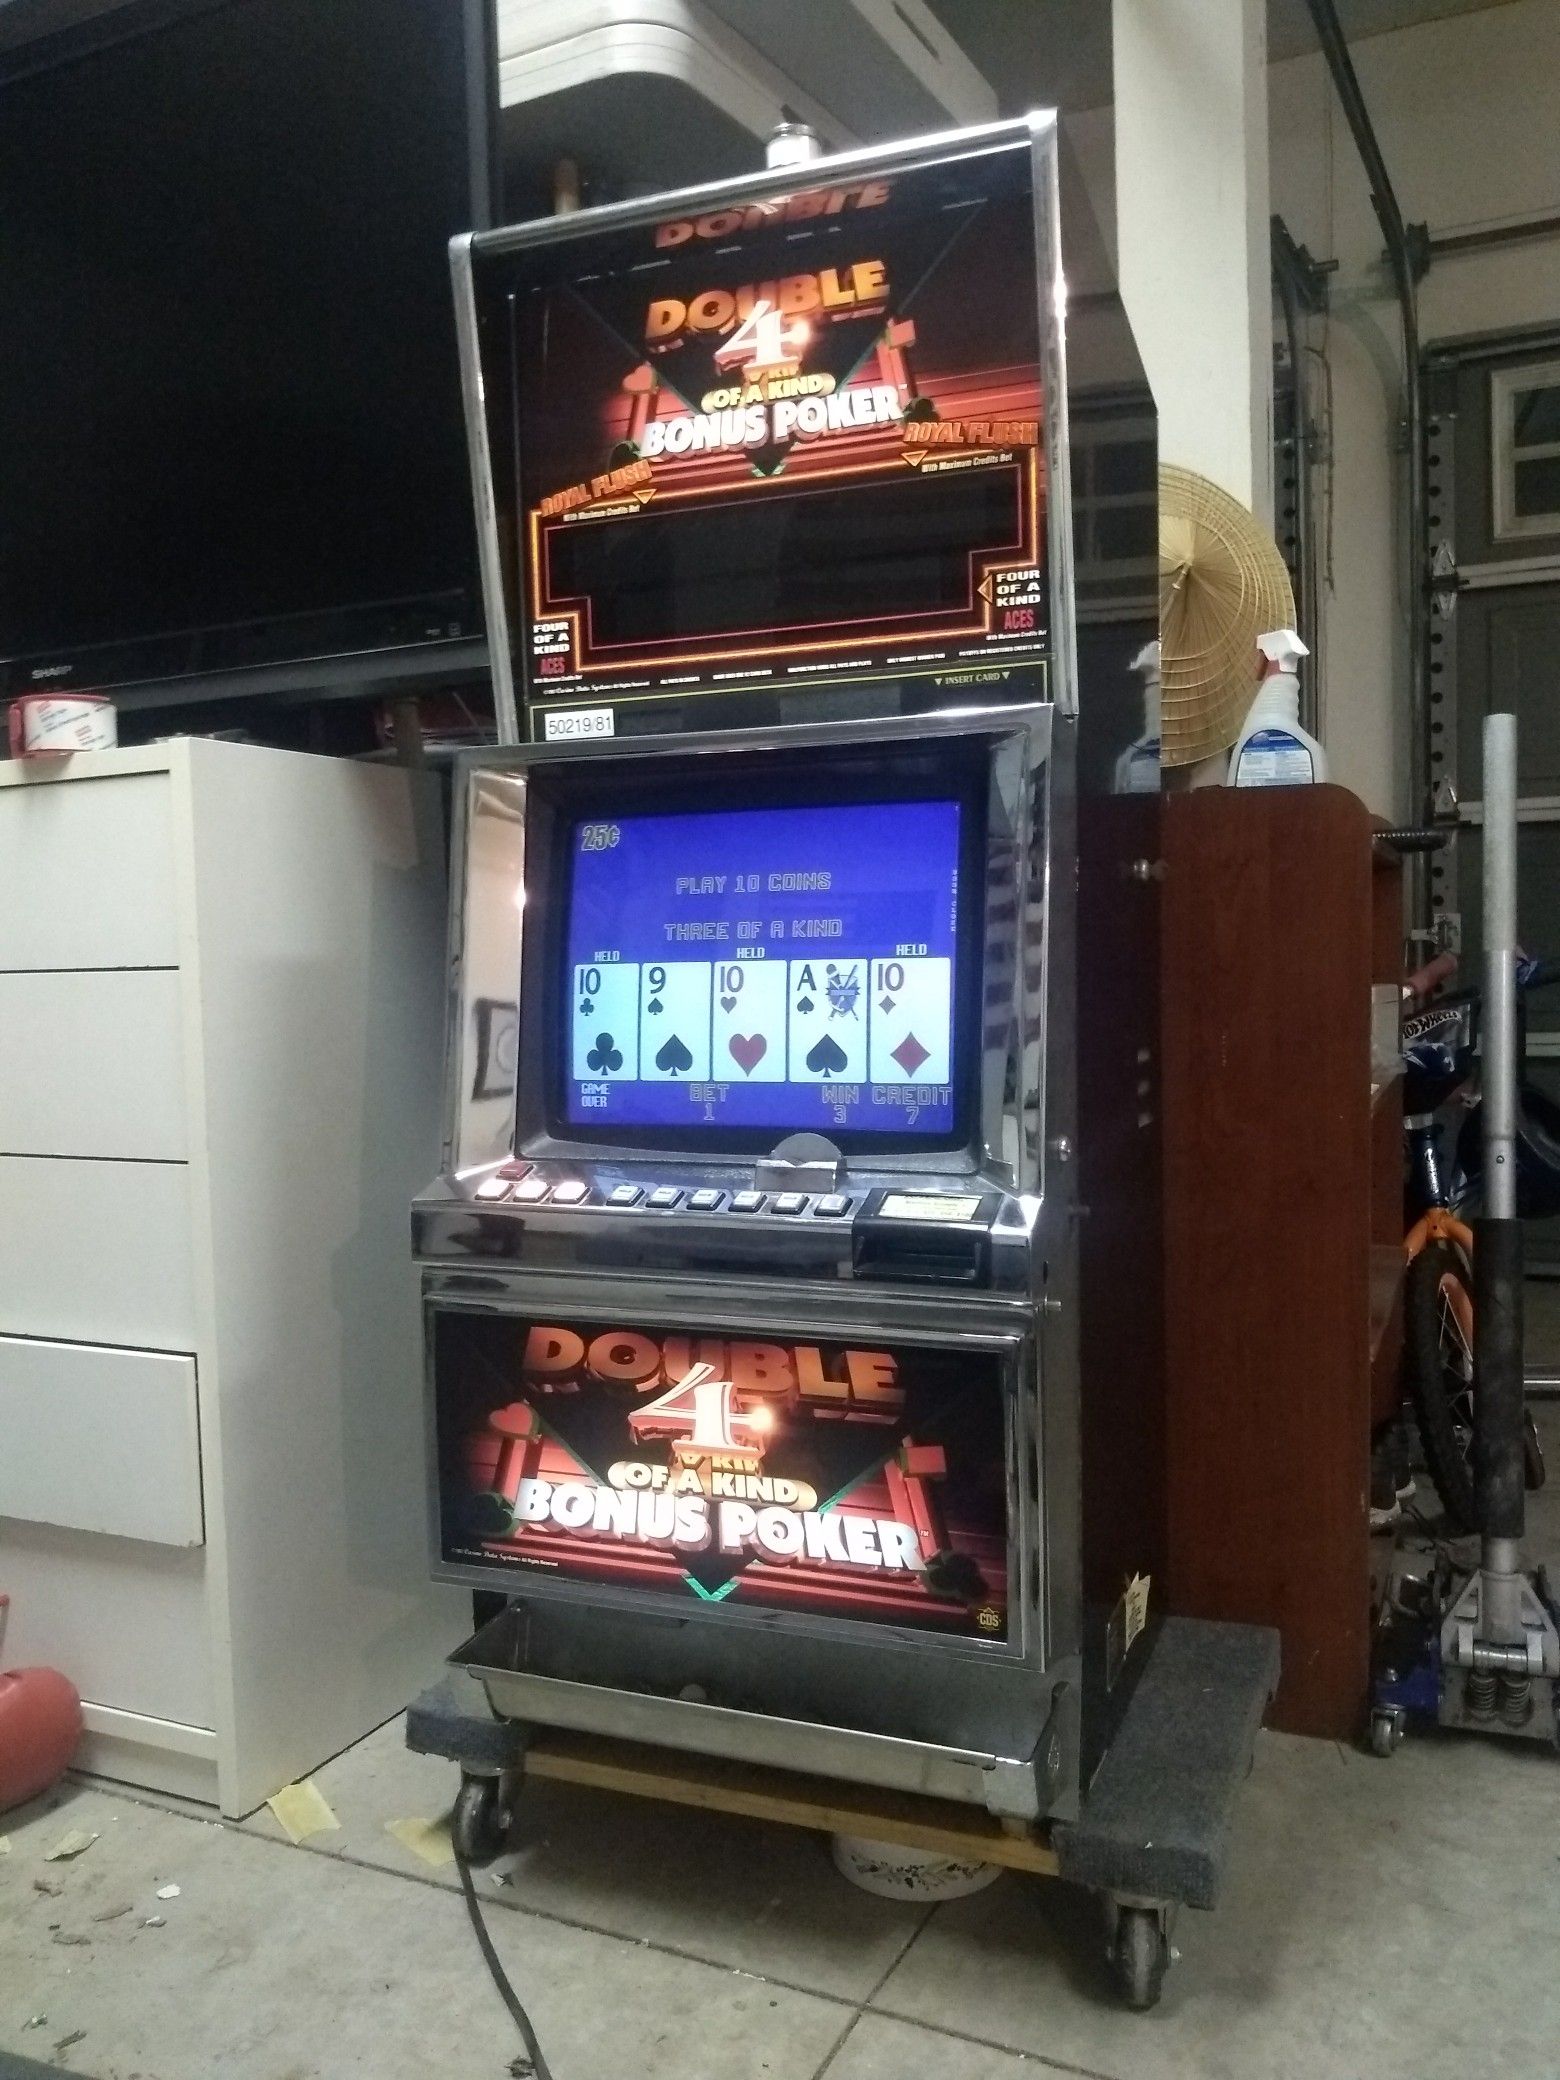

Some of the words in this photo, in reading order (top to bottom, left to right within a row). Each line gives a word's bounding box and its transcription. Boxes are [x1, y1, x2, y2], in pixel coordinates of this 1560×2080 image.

[645, 260, 890, 339] DOUBLE
[714, 300, 804, 369] 4
[713, 389, 741, 409] OF
[744, 386, 768, 405] A
[769, 374, 825, 400] KIND
[639, 405, 767, 457] BONUS
[773, 386, 904, 440] POKER
[903, 422, 964, 443] ROYAL
[967, 422, 1039, 445] FLUSH
[939, 460, 972, 471] Maximum
[973, 455, 999, 466] Credits
[541, 483, 592, 518] ROYAL
[591, 459, 653, 498] FLUSH
[996, 570, 1040, 583] FOUR
[996, 584, 1021, 595] OF
[1026, 582, 1041, 592] A
[996, 594, 1041, 607] KIND
[533, 621, 570, 634] FOUR
[1004, 609, 1035, 630] ACES
[534, 634, 555, 644] OF
[557, 632, 570, 642] A
[533, 643, 570, 655] KIND
[945, 675, 973, 686] INSERT
[975, 672, 1000, 682] CARD
[581, 824, 620, 852] 25¢
[676, 875, 727, 895] PLAY
[734, 873, 760, 893] 10
[768, 872, 831, 891] COINS
[664, 922, 730, 942] THREE
[737, 920, 763, 939] OF
[770, 920, 785, 938] A
[792, 919, 843, 938] KIND
[594, 950, 620, 963] HELD
[736, 946, 765, 960] HELD
[896, 943, 928, 956] HELD
[578, 966, 601, 995] 10
[648, 965, 666, 994] 9
[719, 965, 745, 993] 10
[797, 963, 817, 991] A
[877, 962, 905, 991] 10
[581, 1083, 610, 1095] GAME
[690, 1083, 730, 1102] BET
[822, 1085, 859, 1104] WIN
[872, 1086, 953, 1106] CREDIT
[581, 1096, 607, 1107] OVER
[703, 1102, 715, 1121] 1
[833, 1105, 847, 1124] 3
[906, 1106, 919, 1125] 7
[522, 1325, 900, 1404] DOUBLE
[629, 1362, 772, 1450] 4
[628, 1462, 671, 1490] OF
[677, 1466, 706, 1494] A
[712, 1469, 799, 1505] KIND
[513, 1478, 711, 1549] BONUS
[723, 1501, 928, 1571] POKER
[980, 1612, 999, 1627] CDS
